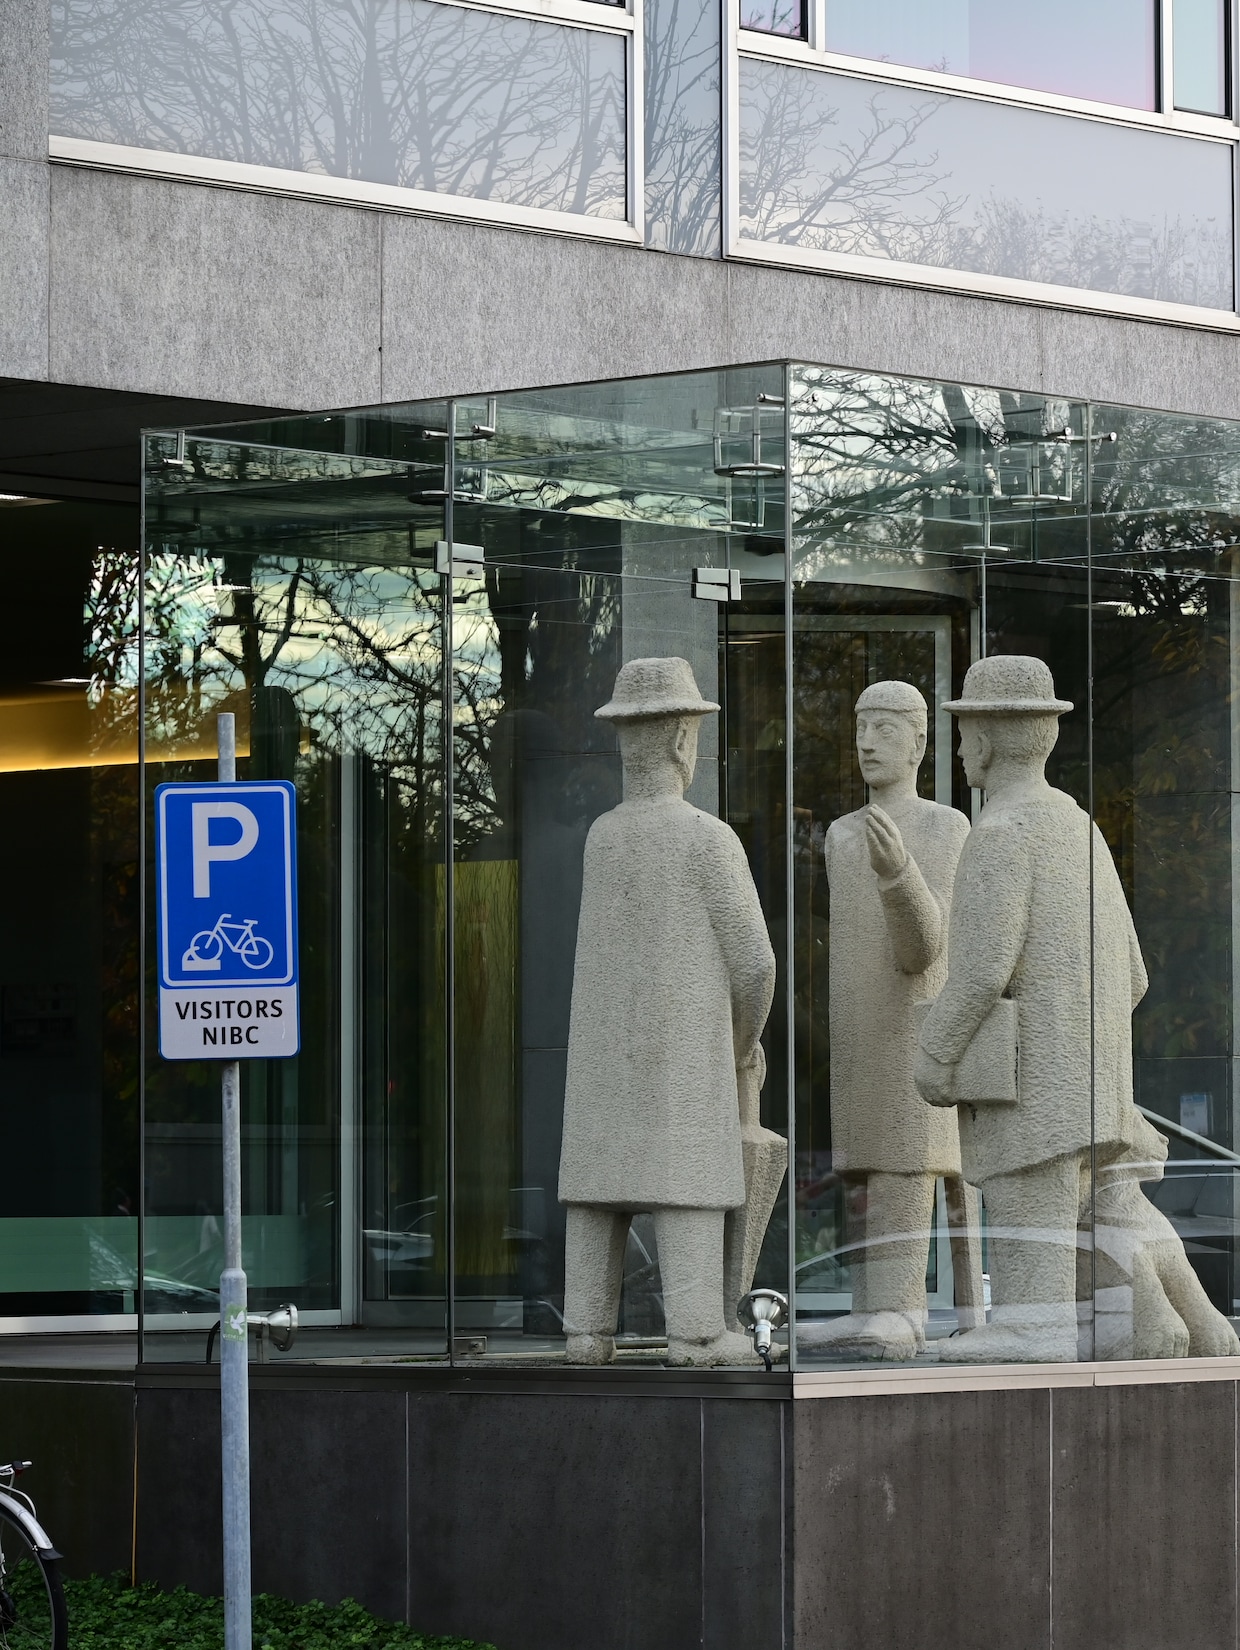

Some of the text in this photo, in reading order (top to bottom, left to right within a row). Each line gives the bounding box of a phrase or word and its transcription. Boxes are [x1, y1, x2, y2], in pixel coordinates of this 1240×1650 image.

[192, 801, 259, 898] P
[175, 999, 283, 1020] VISITORS
[203, 1026, 259, 1046] NIBC
